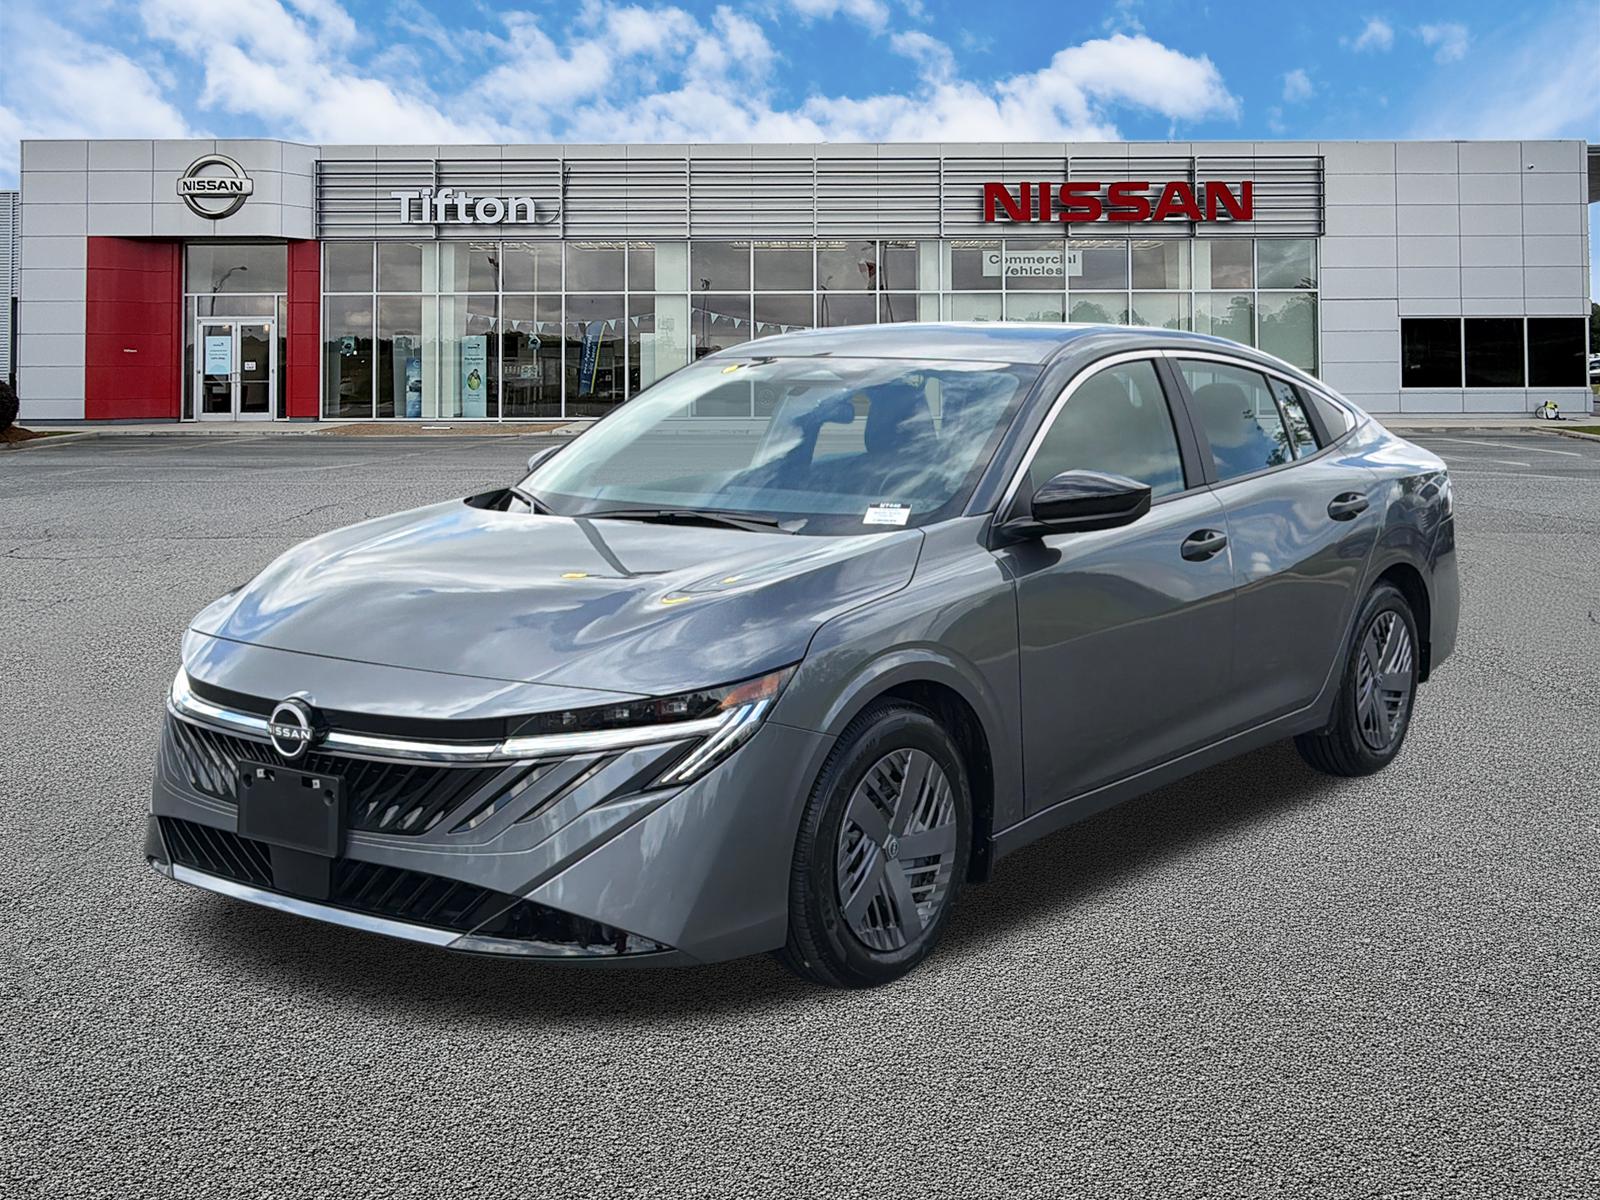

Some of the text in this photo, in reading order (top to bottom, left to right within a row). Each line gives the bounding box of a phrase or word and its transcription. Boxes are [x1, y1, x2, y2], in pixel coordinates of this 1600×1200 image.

[182, 180, 243, 191] NISSAN
[983, 181, 1253, 222] NISSAN
[391, 188, 536, 224] Tifton
